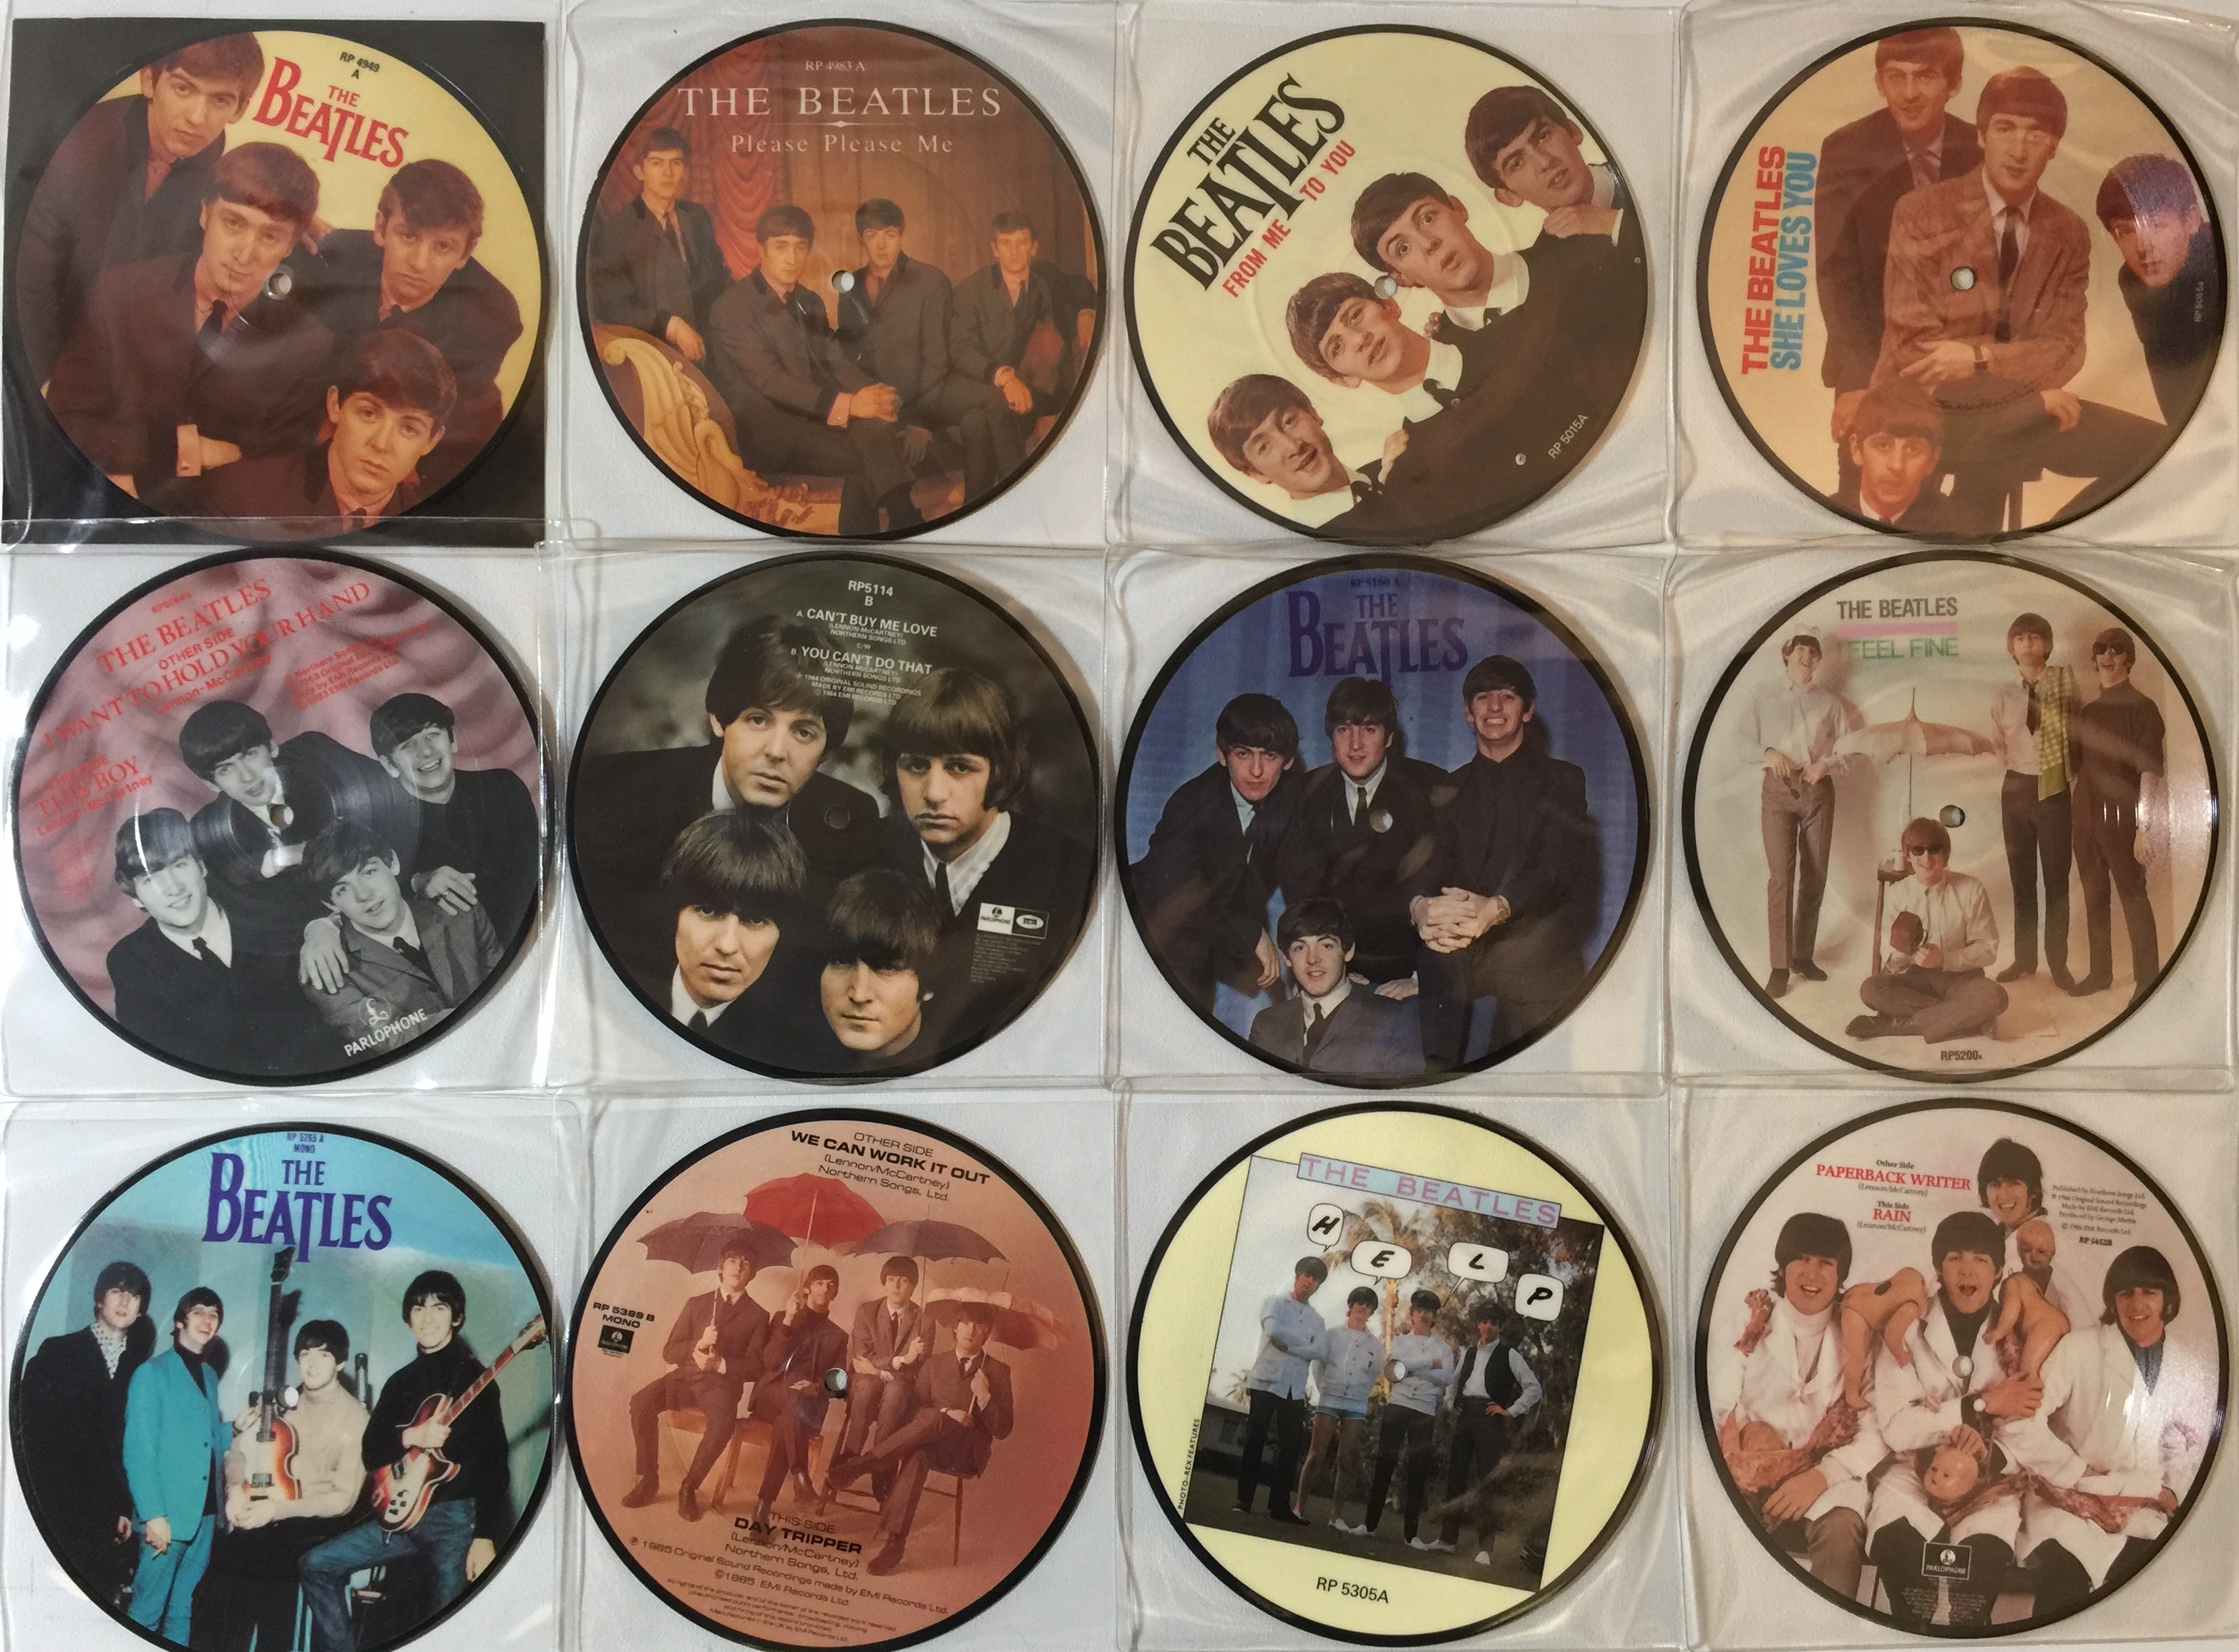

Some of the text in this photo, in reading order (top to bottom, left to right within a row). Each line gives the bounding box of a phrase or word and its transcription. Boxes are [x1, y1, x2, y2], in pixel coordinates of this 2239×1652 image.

[340, 52, 380, 73] RP 4949
[351, 69, 359, 79] A
[805, 60, 823, 72] RP
[854, 62, 865, 72] A
[328, 84, 361, 107] THE
[678, 87, 1001, 116] THE BEATLES
[253, 57, 409, 168] BEATLES
[731, 135, 952, 153] Please Please Me
[1186, 117, 1236, 166] THE
[1149, 72, 1345, 291] BEATLES
[1222, 140, 1355, 298] FROM ME TO YOU
[1742, 146, 1785, 374] THE BEATLES
[1770, 151, 1817, 370] SHE LOVES YOU
[1548, 414, 1589, 459] RP 5015A
[847, 580, 894, 597] RP5114
[864, 595, 874, 607] B
[1355, 593, 1397, 618] THE
[1836, 597, 1958, 620] THE BEATLES
[95, 633, 157, 674] THE
[156, 577, 271, 647] BEATLES
[806, 607, 847, 623] CAN'T
[849, 615, 877, 627] BUY
[879, 618, 899, 631] ME
[902, 622, 937, 637] LOVE
[830, 629, 892, 643] NORTHERN SONGS
[158, 627, 235, 670] OTHER SIDE
[1287, 590, 1468, 688] BEATLES
[1848, 639, 1904, 660] FEEL
[1910, 637, 1959, 658] FINE
[43, 733, 54, 751] I
[54, 697, 122, 741] WANT
[126, 680, 162, 708] TO
[162, 649, 230, 693] HOLD
[294, 582, 370, 627] HAND
[801, 646, 829, 660] YOU
[831, 650, 872, 665] CAN'T
[875, 657, 894, 669] DO
[897, 660, 932, 675] THAT
[824, 667, 861, 678] NORTHERN
[852, 681, 877, 690] SOUND
[93, 756, 139, 791] BOY
[343, 1008, 428, 1057] PARLOPHONE
[287, 1133, 297, 1142] RP
[293, 1143, 315, 1153] MONO
[854, 1132, 934, 1158] OTHER SIDE
[791, 1130, 990, 1184] WE CAN WORK IT OUT
[824, 1153, 950, 1189] (Lennon/McCartney)
[1876, 1160, 1898, 1168] Other
[281, 1160, 326, 1186] THE
[819, 1165, 950, 1201] Northern Songs, Ltd.
[1815, 1164, 1971, 1191] PAPERBACK WRITER
[1302, 1156, 1556, 1226] THE BEATLES
[201, 1153, 392, 1263] BEATLES
[1873, 1208, 1911, 1222] RAIN
[1312, 1216, 1553, 1305] H E L P
[592, 1302, 610, 1311] RP
[612, 1306, 644, 1319] 5389
[603, 1314, 640, 1328] MONO
[1187, 1418, 1200, 1460] FEATURES
[734, 1517, 862, 1554] DAY TRIPPER
[770, 1511, 835, 1534] THIS SIDE
[725, 1543, 859, 1580] Northern Songs, Ltd.
[731, 1532, 859, 1568] (Lennon/McCartney)
[674, 1548, 714, 1563] Original
[716, 1557, 751, 1570] Sound
[753, 1565, 811, 1585] Recordings
[814, 1581, 843, 1593] made
[845, 1586, 858, 1597] by
[860, 1589, 880, 1600] EMI
[883, 1594, 927, 1610] Records
[1926, 1564, 1966, 1574] PARLOPHONE
[760, 1580, 781, 1591] EMI
[784, 1585, 828, 1602] Records
[1317, 1577, 1388, 1604] RP 5305A
